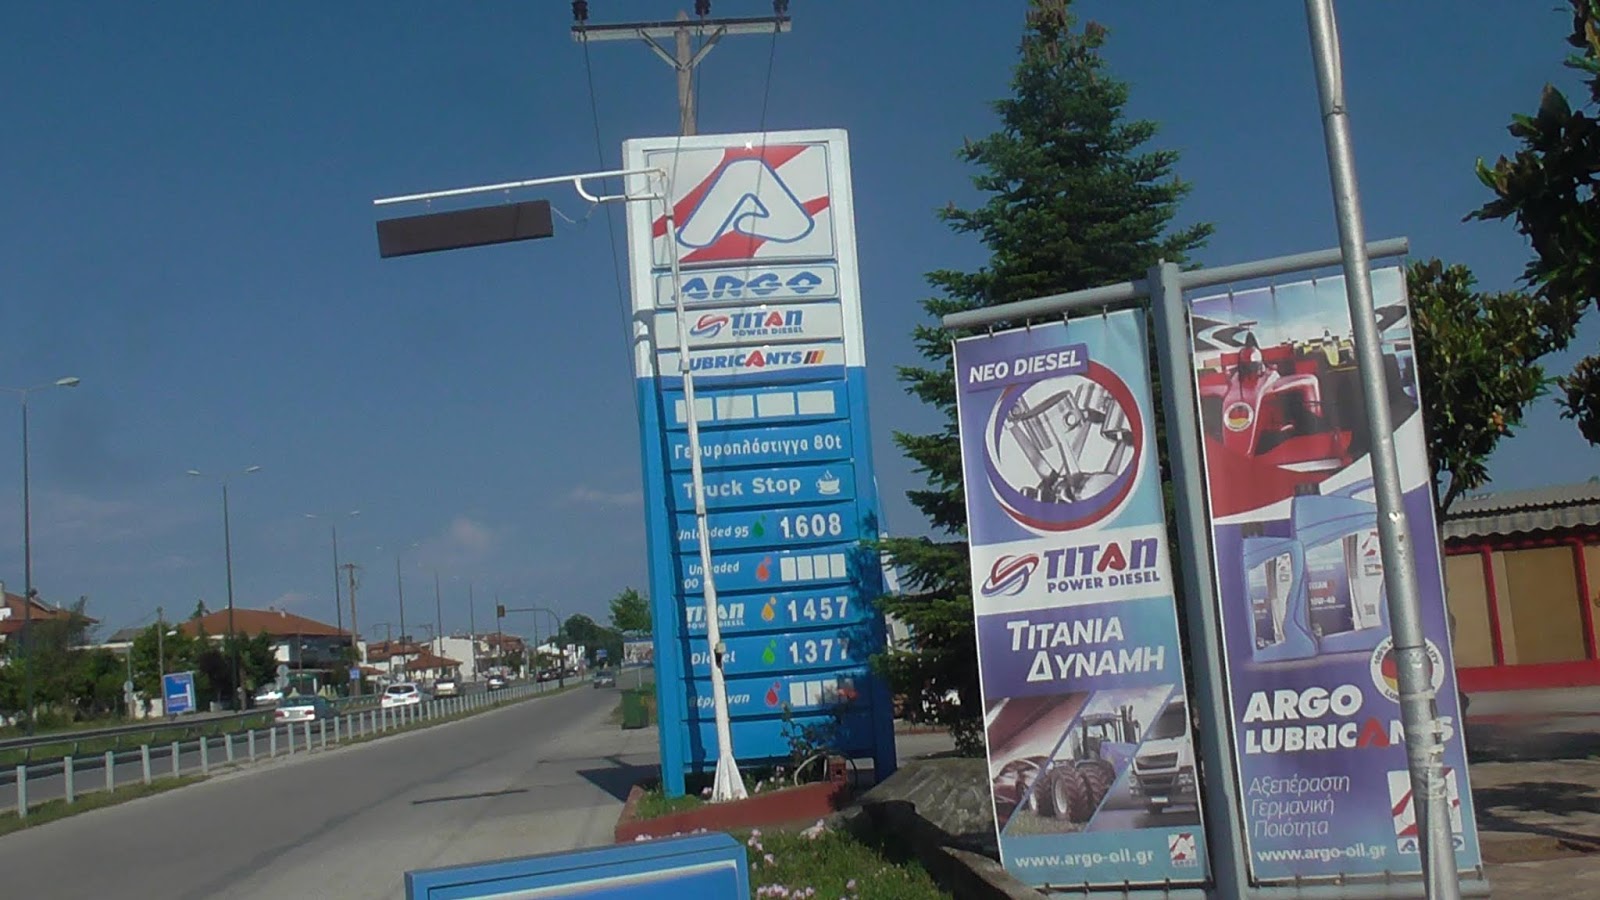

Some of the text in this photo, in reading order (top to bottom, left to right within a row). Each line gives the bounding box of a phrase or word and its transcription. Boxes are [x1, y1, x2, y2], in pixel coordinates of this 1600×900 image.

[671, 271, 822, 300] ARGO
[732, 326, 803, 336] POWER DIESEL
[969, 350, 1081, 383] NEO DIESEL
[674, 437, 808, 460] Γευροπλάστιγγα
[683, 477, 801, 499] Tuck Stop
[734, 526, 749, 538] 95
[688, 561, 740, 576] Unaded
[1047, 571, 1160, 593] POWER DIESEL
[1007, 616, 1124, 651] ΤΙΤΑΝΙΑ
[1026, 645, 1165, 682] ΔΥΝΑΜΗ
[1242, 684, 1363, 723] ARGO
[1245, 716, 1454, 754] LUBRICANS
[1248, 773, 1350, 796] Αξεπέραστη
[1251, 793, 1335, 818] Γερμανική
[1254, 817, 1329, 838] Ποιότητα
[1015, 848, 1155, 868] www.argo-oil.gr
[1256, 843, 1388, 863] www.argo-oil.gr
